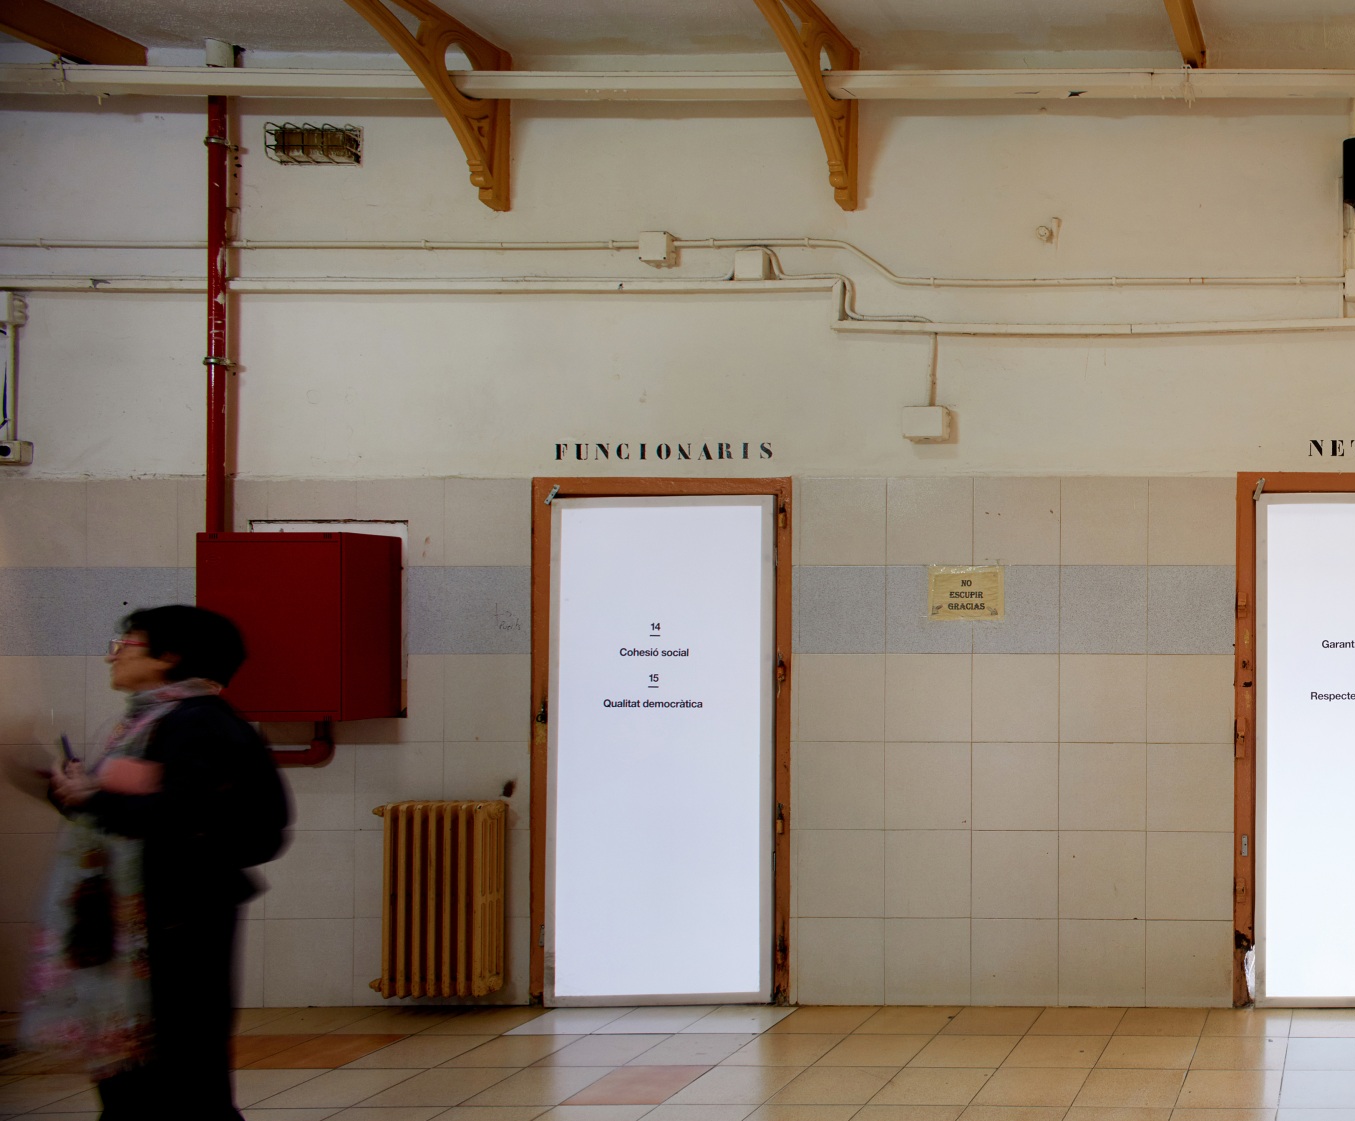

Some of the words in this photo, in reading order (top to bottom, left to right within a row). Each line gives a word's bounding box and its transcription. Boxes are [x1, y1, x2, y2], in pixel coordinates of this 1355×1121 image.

[554, 442, 773, 461] FUNCIONARIS
[960, 579, 973, 587] NO
[948, 591, 984, 599] ESCUPIR
[947, 602, 986, 611] GRACIAS
[650, 622, 661, 632] 14
[619, 647, 659, 657] Cohesió
[660, 648, 690, 658] social
[648, 673, 660, 683] 15
[602, 698, 641, 708] Qualitat
[642, 698, 704, 709] democràtica
